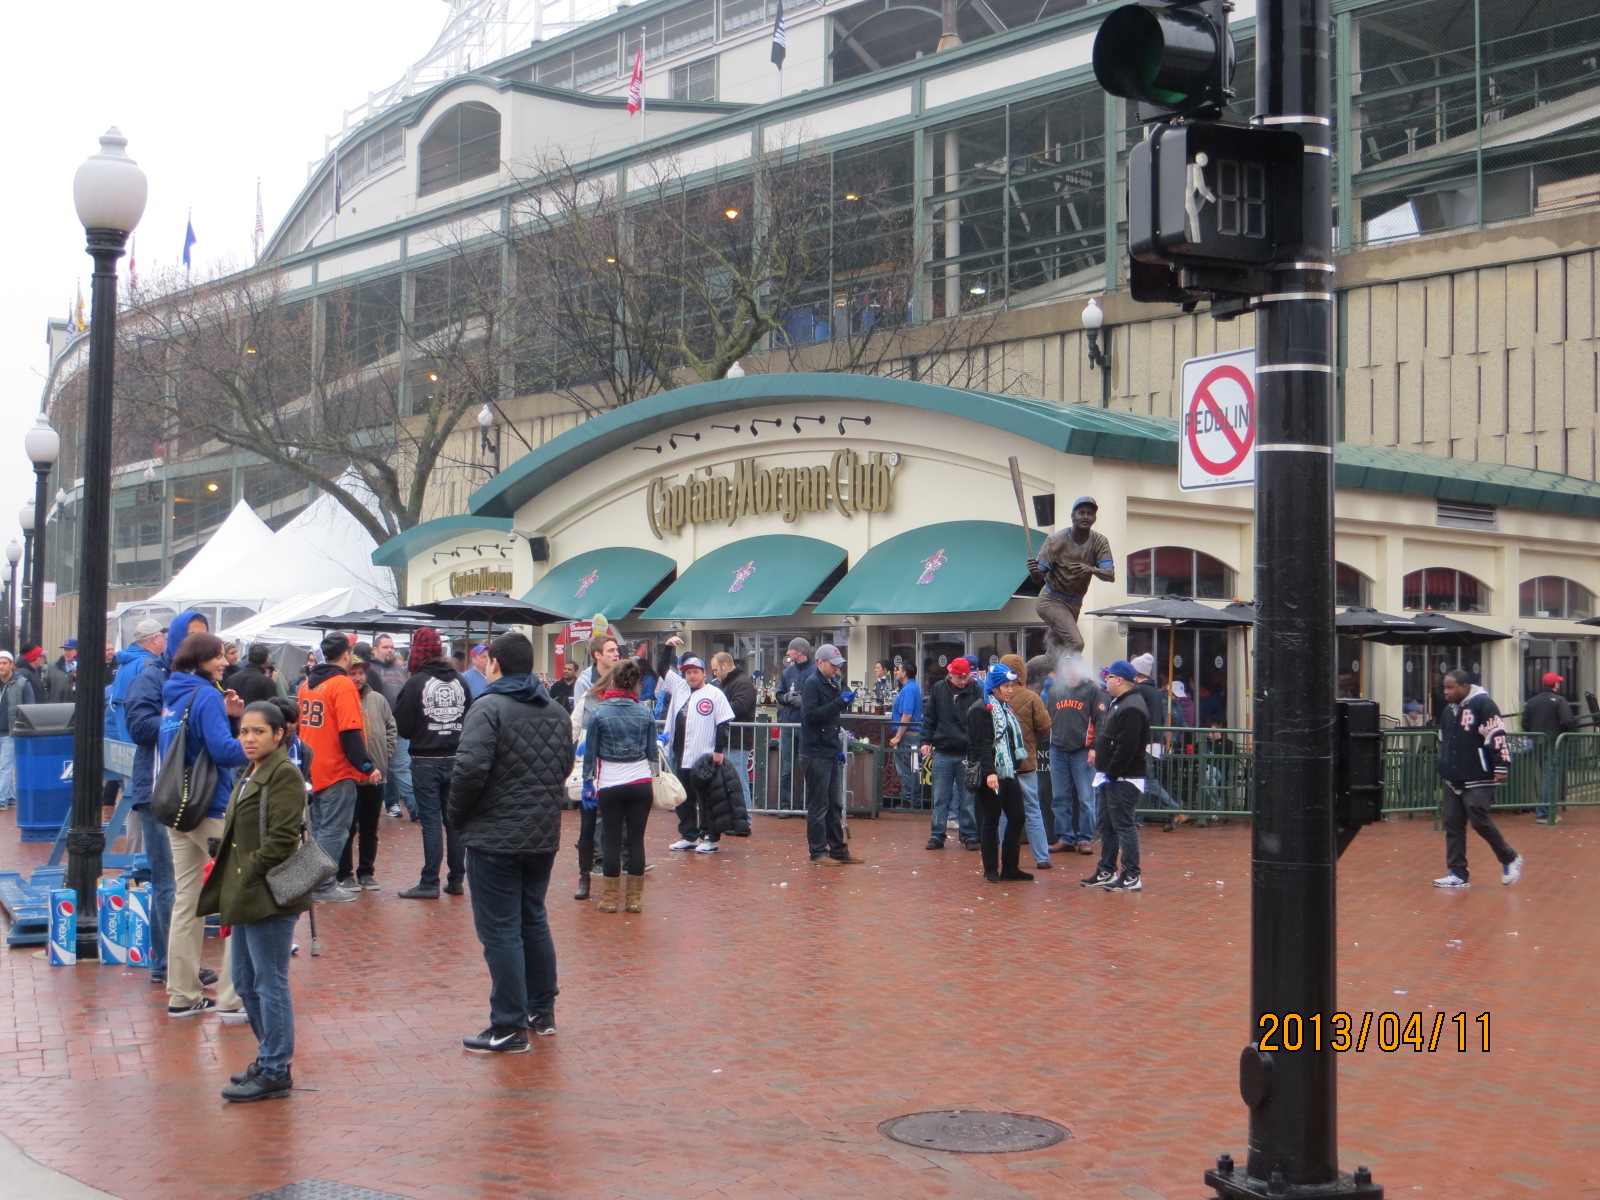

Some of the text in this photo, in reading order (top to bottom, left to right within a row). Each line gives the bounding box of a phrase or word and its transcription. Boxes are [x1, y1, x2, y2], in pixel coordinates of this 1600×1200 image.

[646, 448, 891, 541] Captain Morgan Club
[301, 698, 325, 729] 28
[1055, 699, 1084, 710] GIANTS
